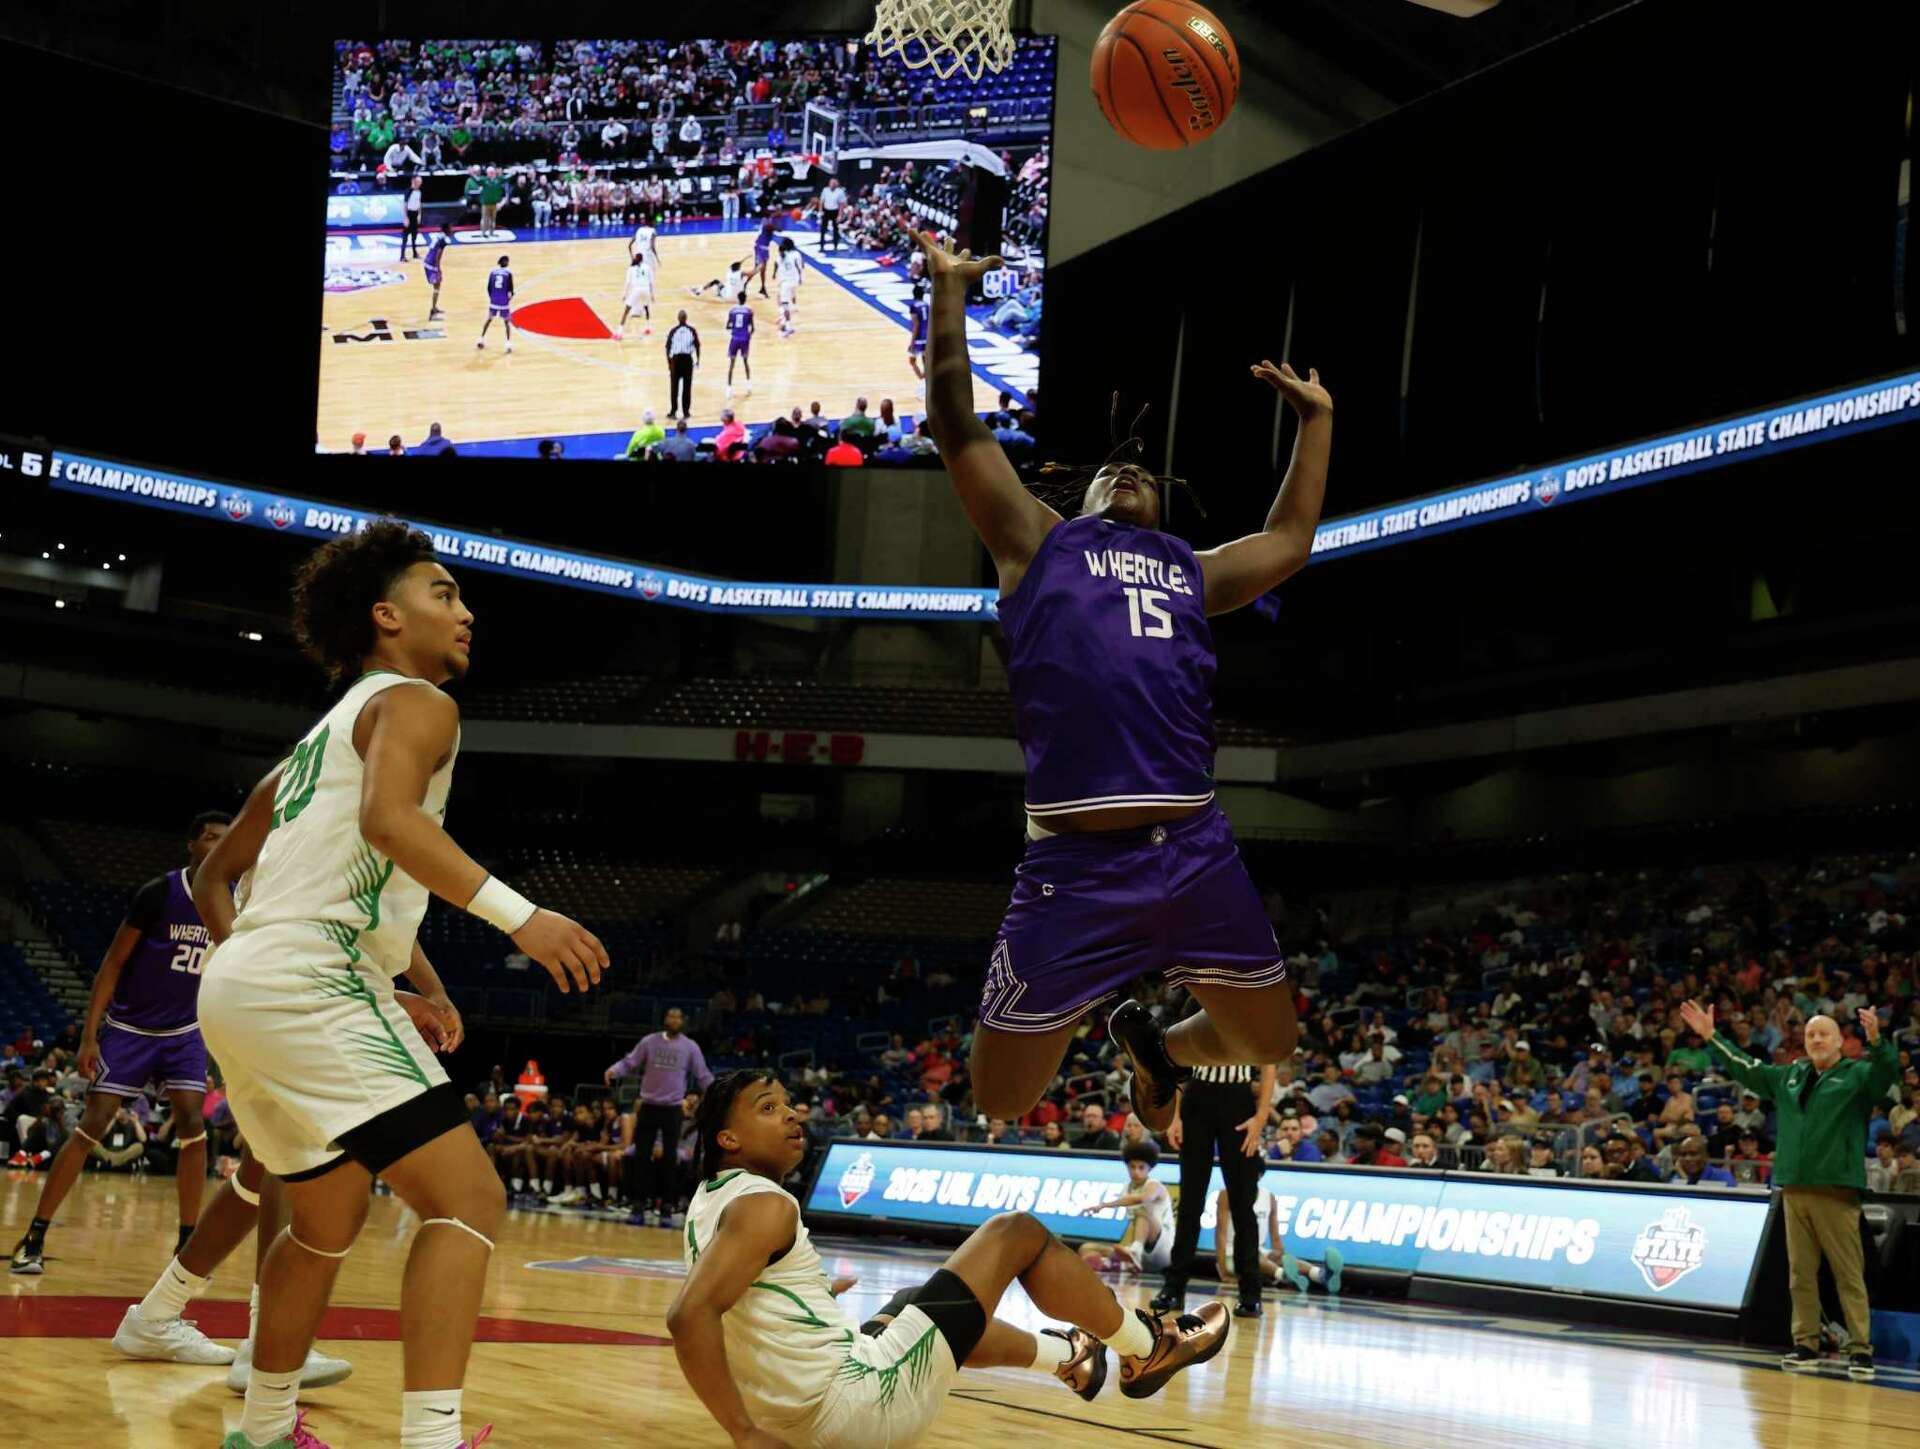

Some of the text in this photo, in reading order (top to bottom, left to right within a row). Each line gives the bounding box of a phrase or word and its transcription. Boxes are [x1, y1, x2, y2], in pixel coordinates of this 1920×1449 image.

[1163, 49, 1214, 131] Baden
[1564, 382, 1920, 491] BOYS BASKETBALL STATE CHAMPIONSHIPS
[21, 451, 43, 477] 5
[66, 461, 218, 508] CHAMPIONSHIPS
[305, 508, 352, 534] BOYS
[1311, 480, 1531, 554] ASKETBALL STATE CHAMPIONSHIPS
[464, 540, 508, 564] STATE
[510, 549, 634, 589] CHAMPIONSHIPS
[666, 579, 708, 602] BOYS
[709, 587, 808, 608] BASKETBALL
[811, 590, 854, 609] STATE
[856, 591, 983, 613] CHAMPIONSHIPS
[1122, 587, 1174, 639] 15
[270, 722, 331, 832] 20
[170, 944, 204, 975] 20
[882, 1166, 942, 1204] 2025
[936, 1170, 975, 1207] UIL
[971, 1173, 1040, 1212] BOYS
[1294, 1196, 1600, 1266] CHAMPIONSHIPS
[1633, 1235, 1703, 1263] STATE
